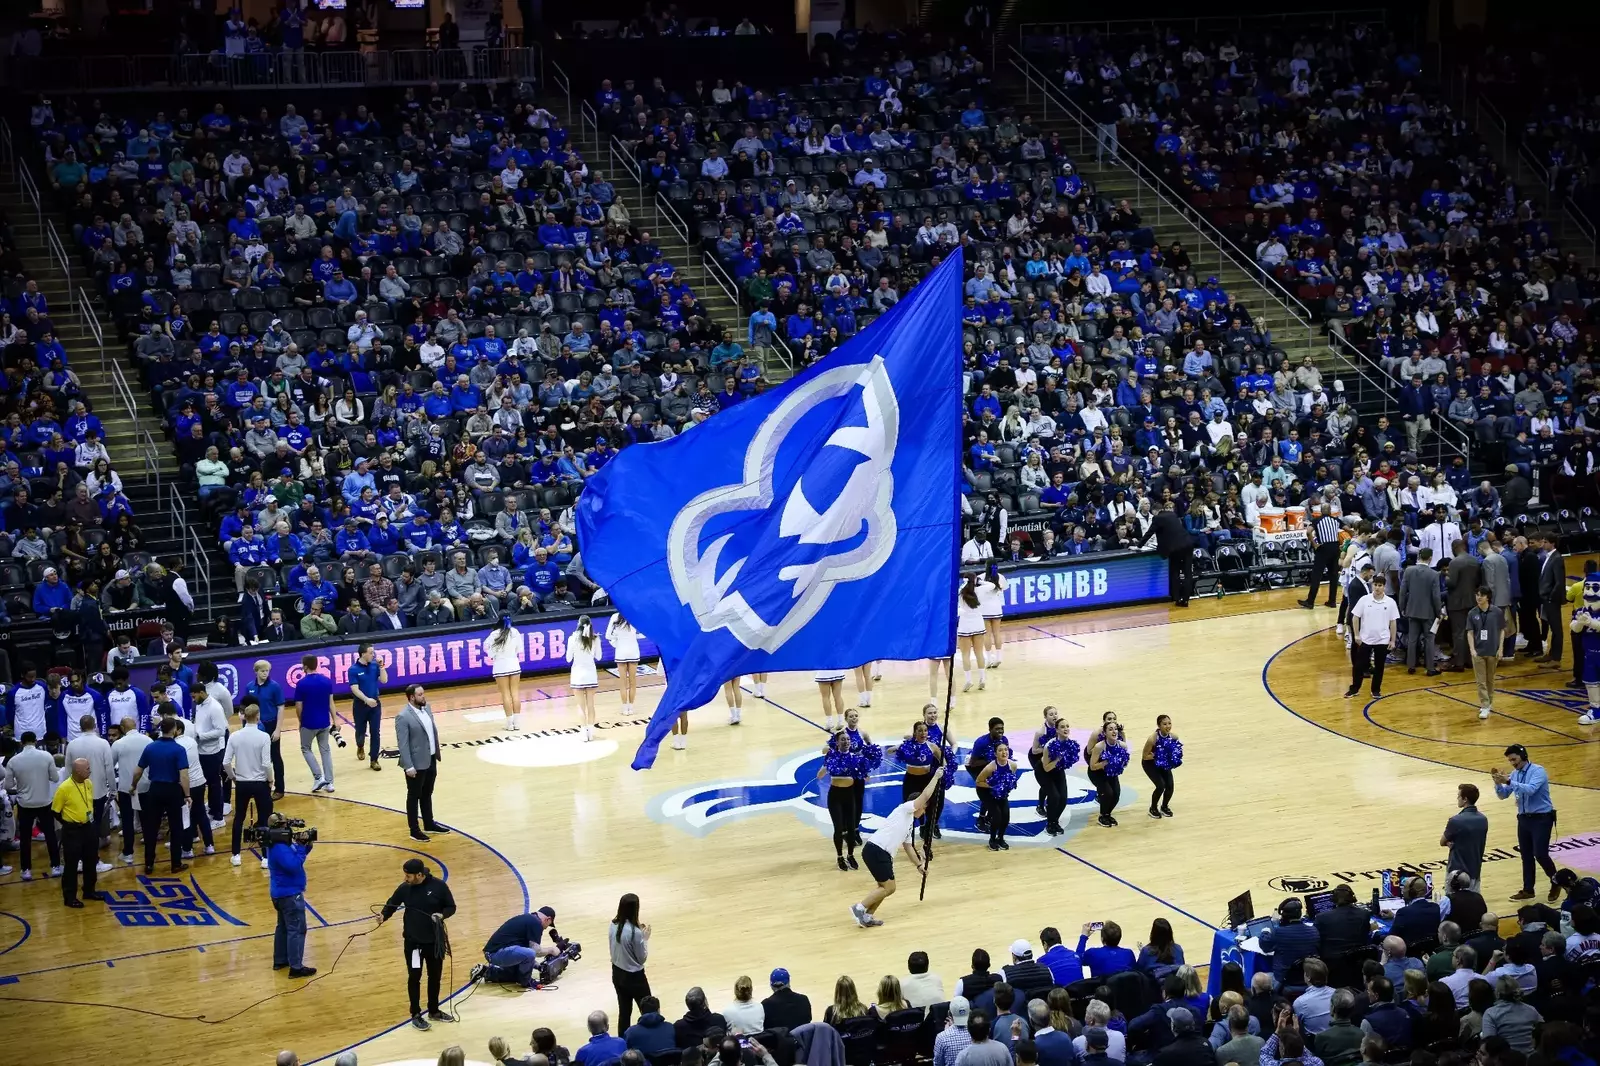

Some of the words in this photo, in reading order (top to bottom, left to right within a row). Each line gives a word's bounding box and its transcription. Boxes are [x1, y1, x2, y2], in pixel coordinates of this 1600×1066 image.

[1006, 521, 1042, 534] udential
[1275, 532, 1303, 540] GATORADE
[1001, 568, 1108, 605] TESMBB
[108, 618, 134, 631] ntial
[97, 891, 170, 926] BIG
[136, 875, 220, 926] EAST
